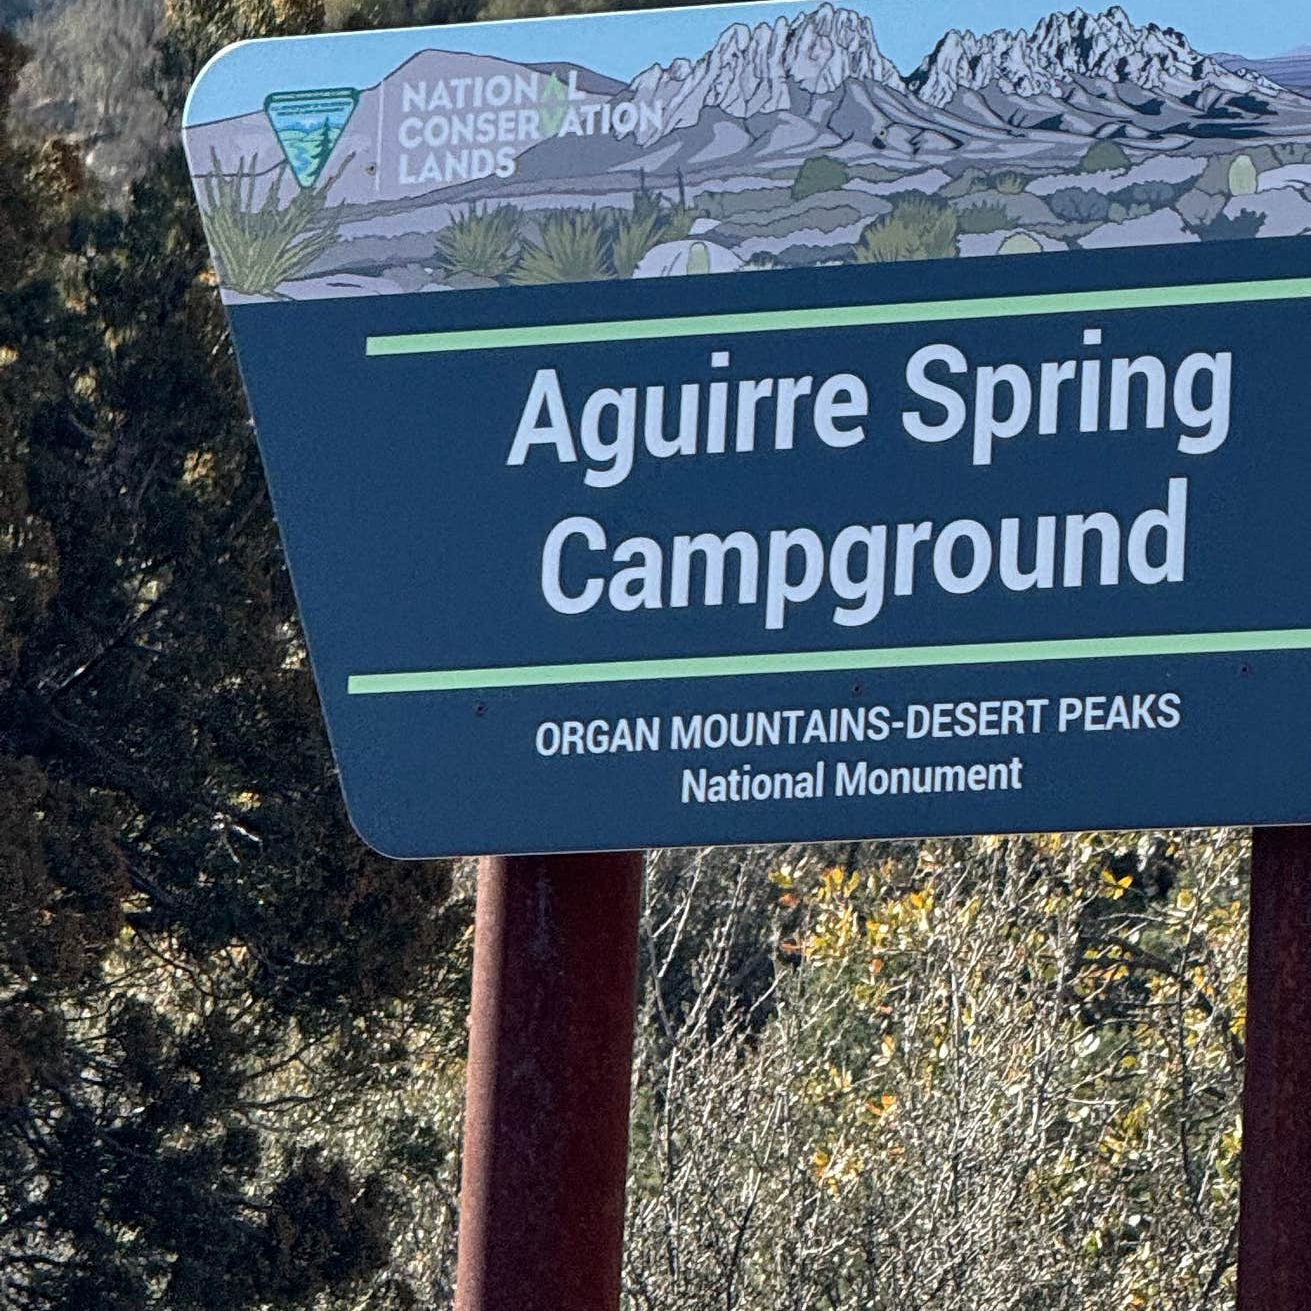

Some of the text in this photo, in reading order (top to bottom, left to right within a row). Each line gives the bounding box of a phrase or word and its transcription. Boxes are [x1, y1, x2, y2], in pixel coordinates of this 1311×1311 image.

[402, 70, 585, 112] NATIONAL
[398, 101, 664, 149] CONSERVATION
[399, 146, 516, 184] LANDS
[506, 328, 1232, 488] Aguirre Spring
[541, 476, 1188, 630] Campground
[534, 692, 1181, 757] ORGAN MOUNTAINS-DESERT PEAKS
[680, 756, 1024, 804] National Monument
